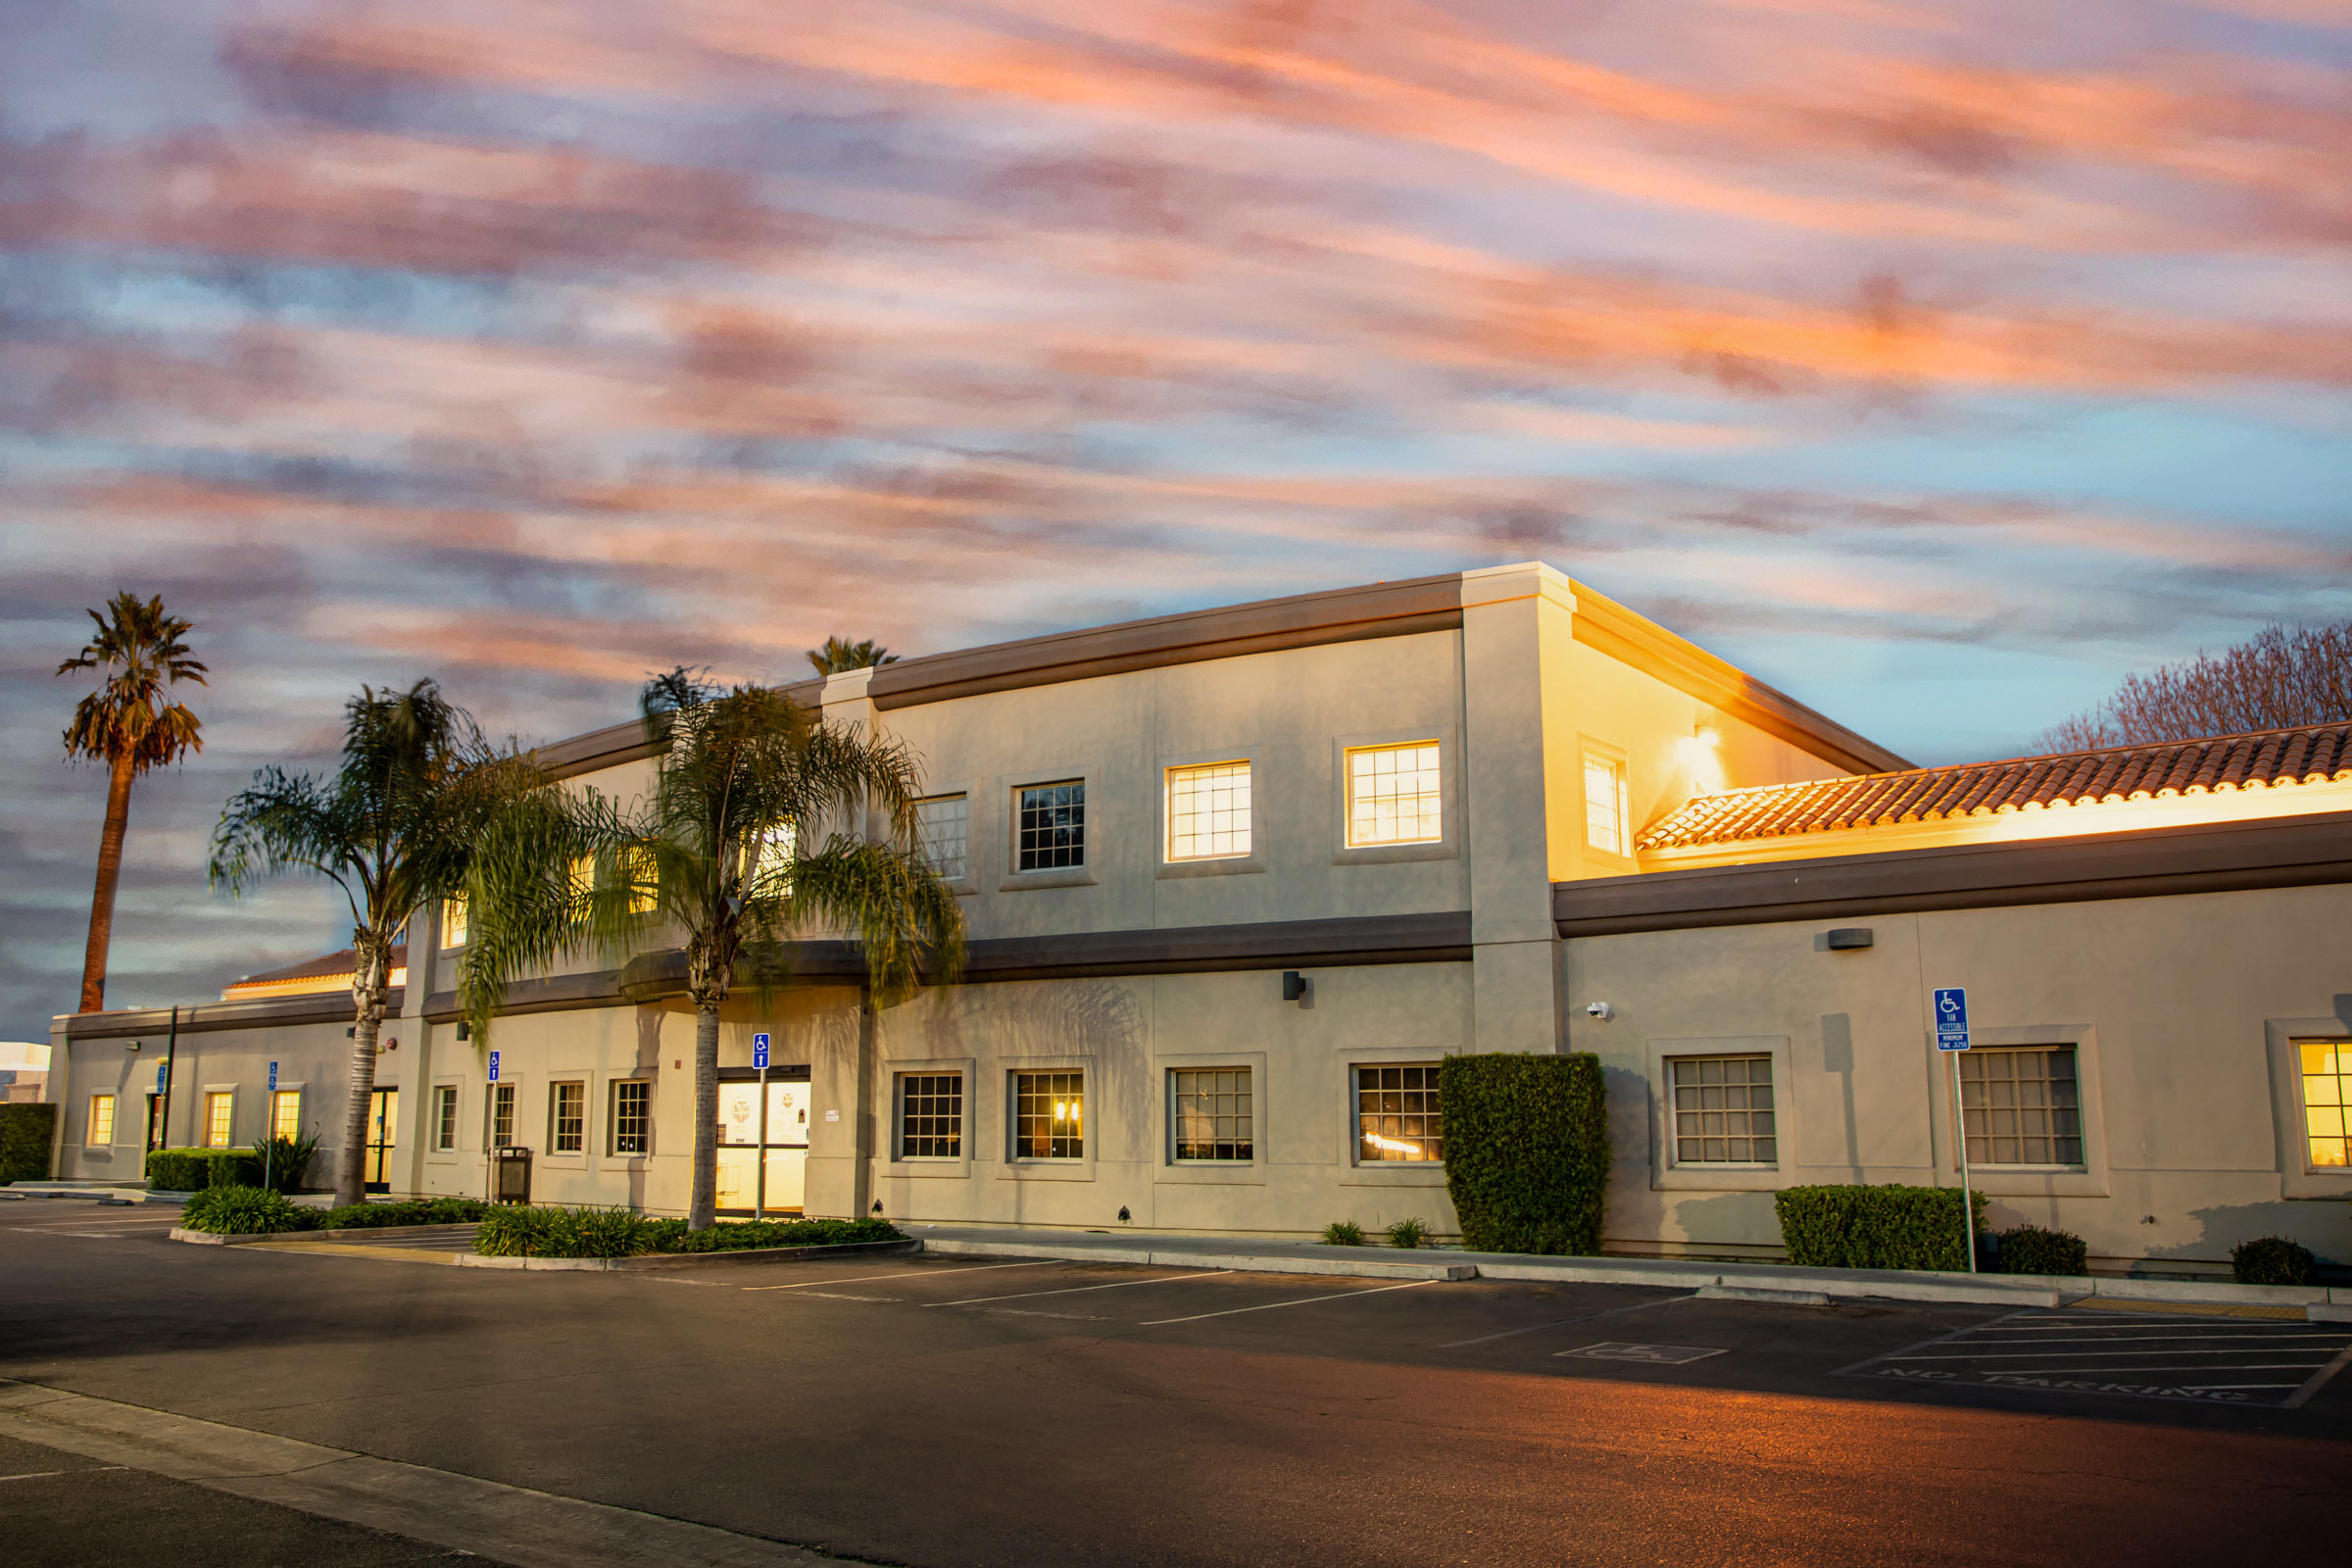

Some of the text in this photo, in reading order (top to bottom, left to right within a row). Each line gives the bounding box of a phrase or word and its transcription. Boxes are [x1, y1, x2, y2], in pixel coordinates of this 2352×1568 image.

[1939, 1022, 1965, 1031] ACCESSIBLE
[1878, 1368, 2252, 1401] NO PARKING
